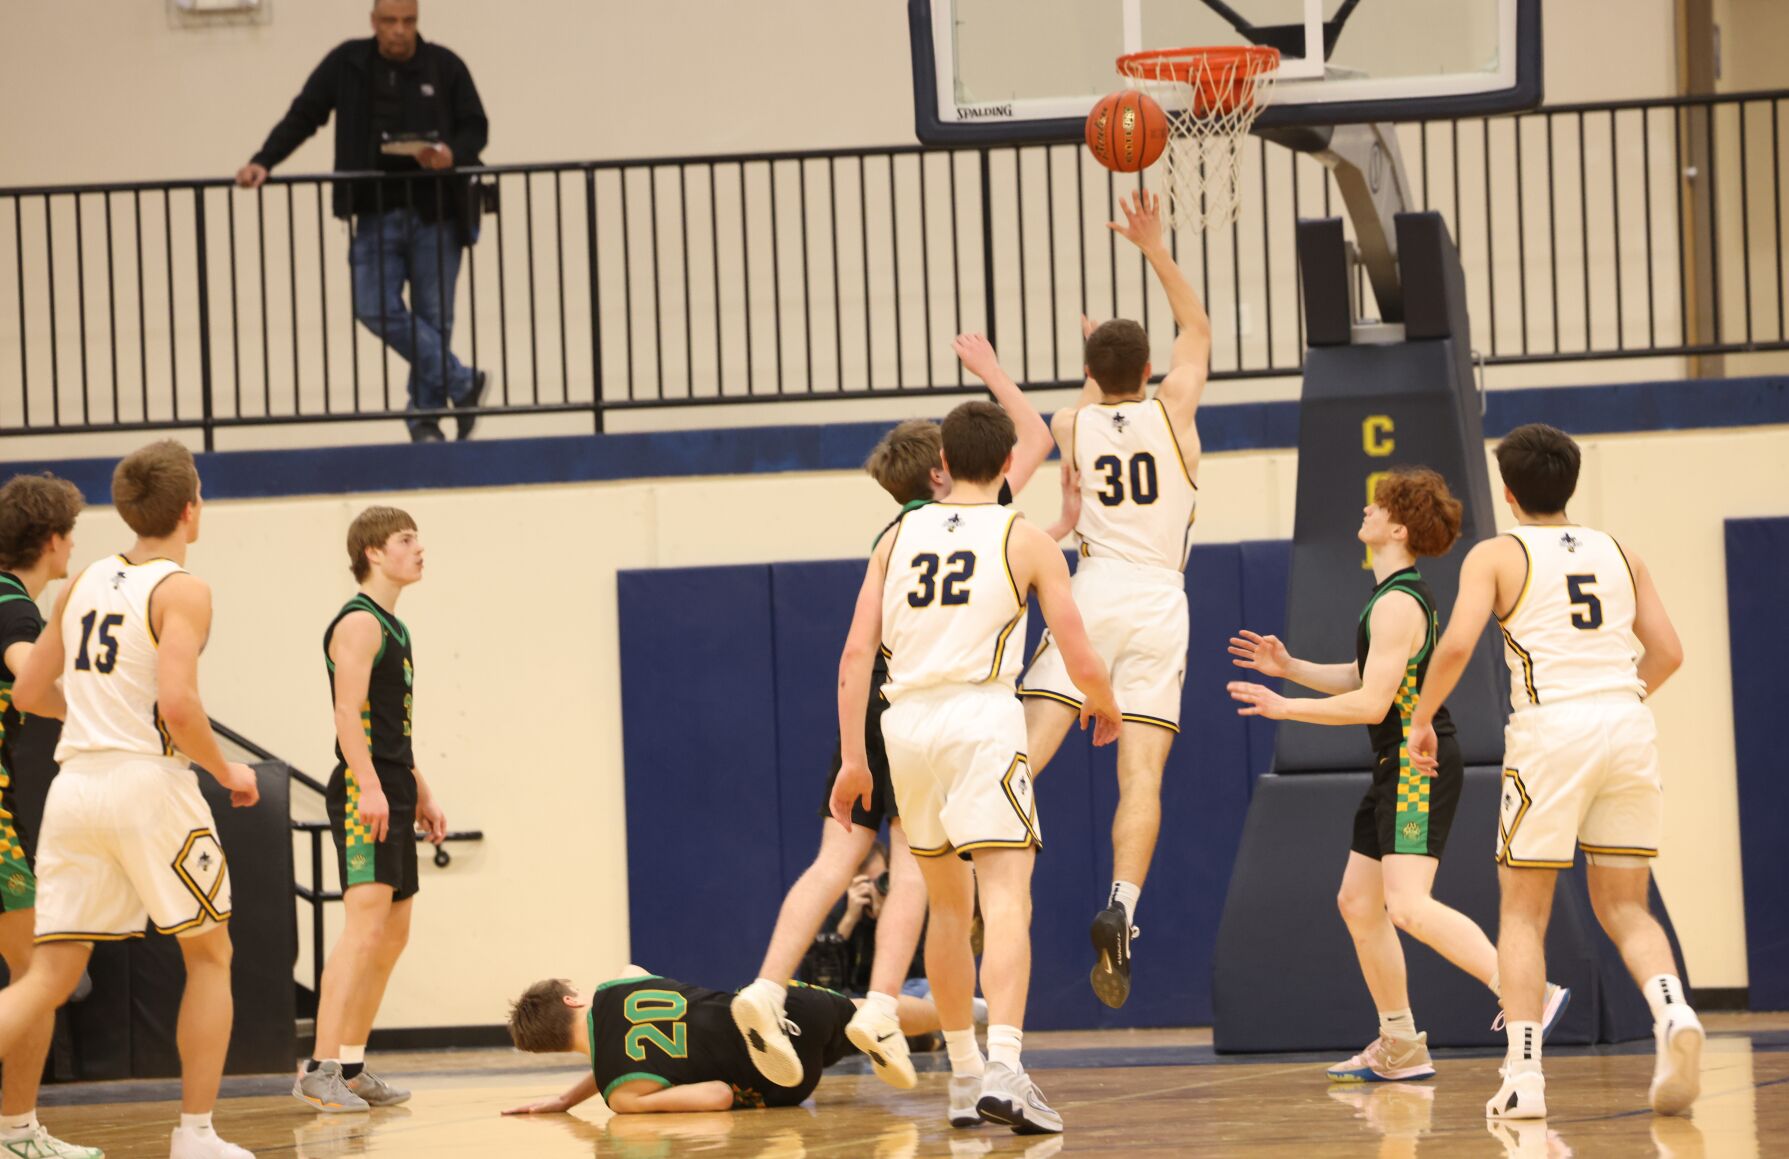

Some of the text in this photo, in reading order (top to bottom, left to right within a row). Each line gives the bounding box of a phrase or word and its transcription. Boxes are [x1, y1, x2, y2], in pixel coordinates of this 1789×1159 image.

[957, 103, 1013, 120] SPALDING
[1094, 451, 1159, 507] 30
[907, 550, 976, 608] 32
[1565, 573, 1603, 630] 5
[74, 608, 125, 674] 15
[624, 989, 688, 1062] 20
